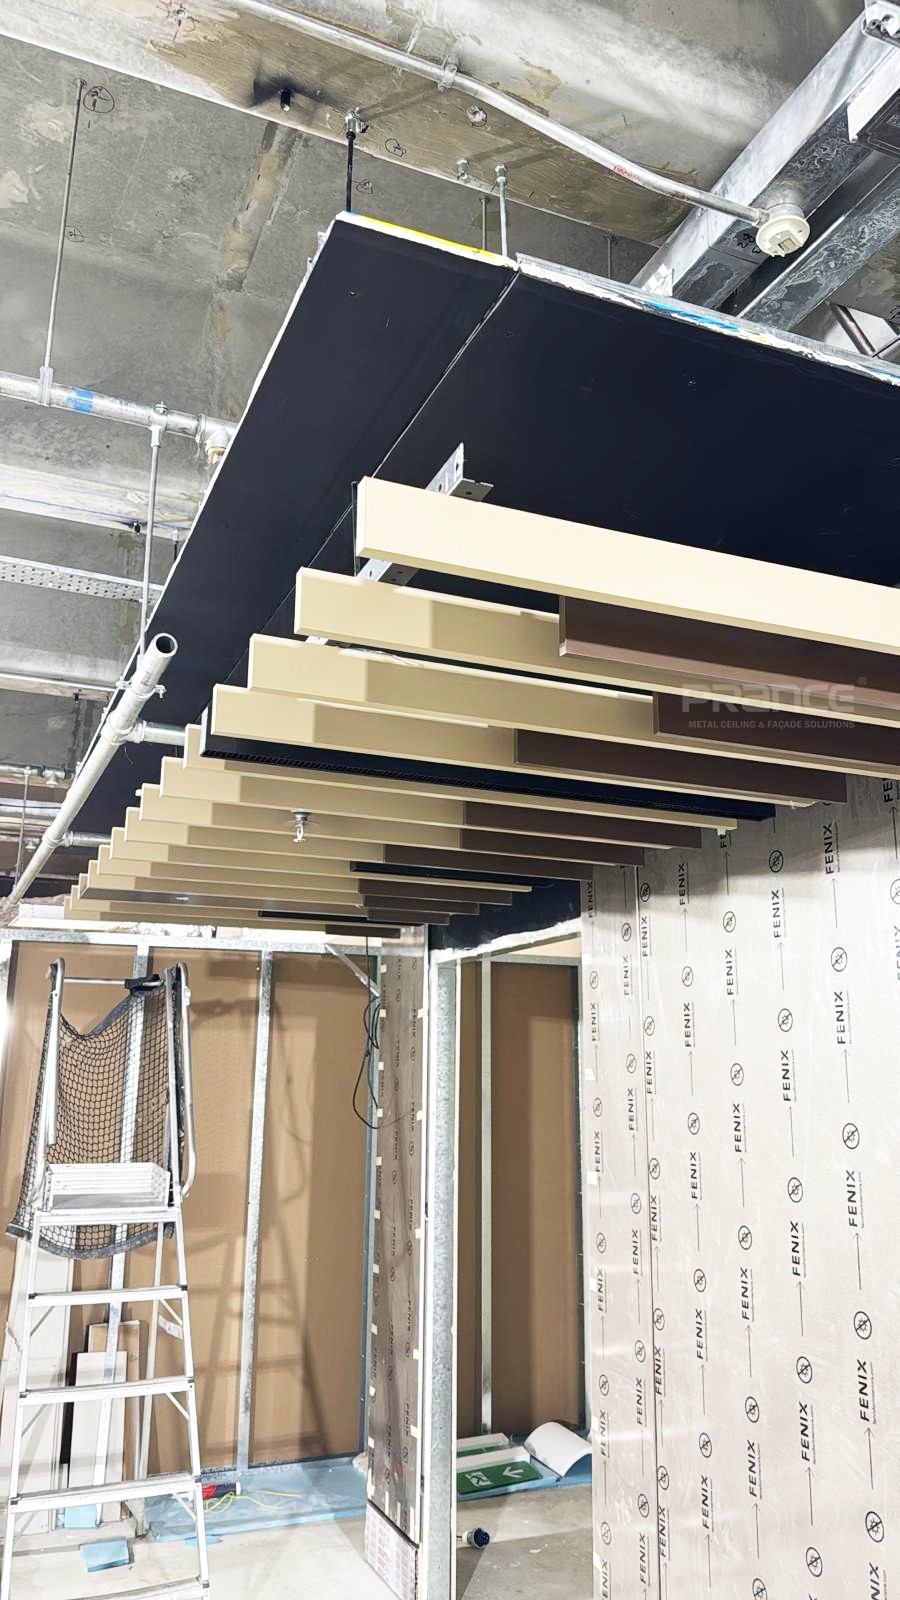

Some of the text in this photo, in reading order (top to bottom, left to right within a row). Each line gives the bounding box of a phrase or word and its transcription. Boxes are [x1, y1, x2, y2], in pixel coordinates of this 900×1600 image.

[822, 822, 833, 874] FENIX
[771, 888, 781, 938] FENIX
[726, 948, 734, 995] FENIX
[834, 990, 846, 1044] FENIX
[780, 1049, 791, 1101] FENIX
[732, 1102, 742, 1152] FENIX
[690, 1151, 698, 1199] FENIX
[846, 1169, 858, 1227] FENIX
[790, 1220, 801, 1277] FENIX
[740, 1266, 750, 1320] FENIX
[695, 1308, 704, 1359] FENIX
[654, 1345, 662, 1395] FENIX
[856, 1359, 869, 1422] FENIX
[799, 1401, 810, 1462] FENIX
[746, 1439, 757, 1497] FENIX
[701, 1475, 710, 1529] FENIX
[658, 1504, 666, 1557] FENIX
[869, 1562, 880, 1600] NIX
